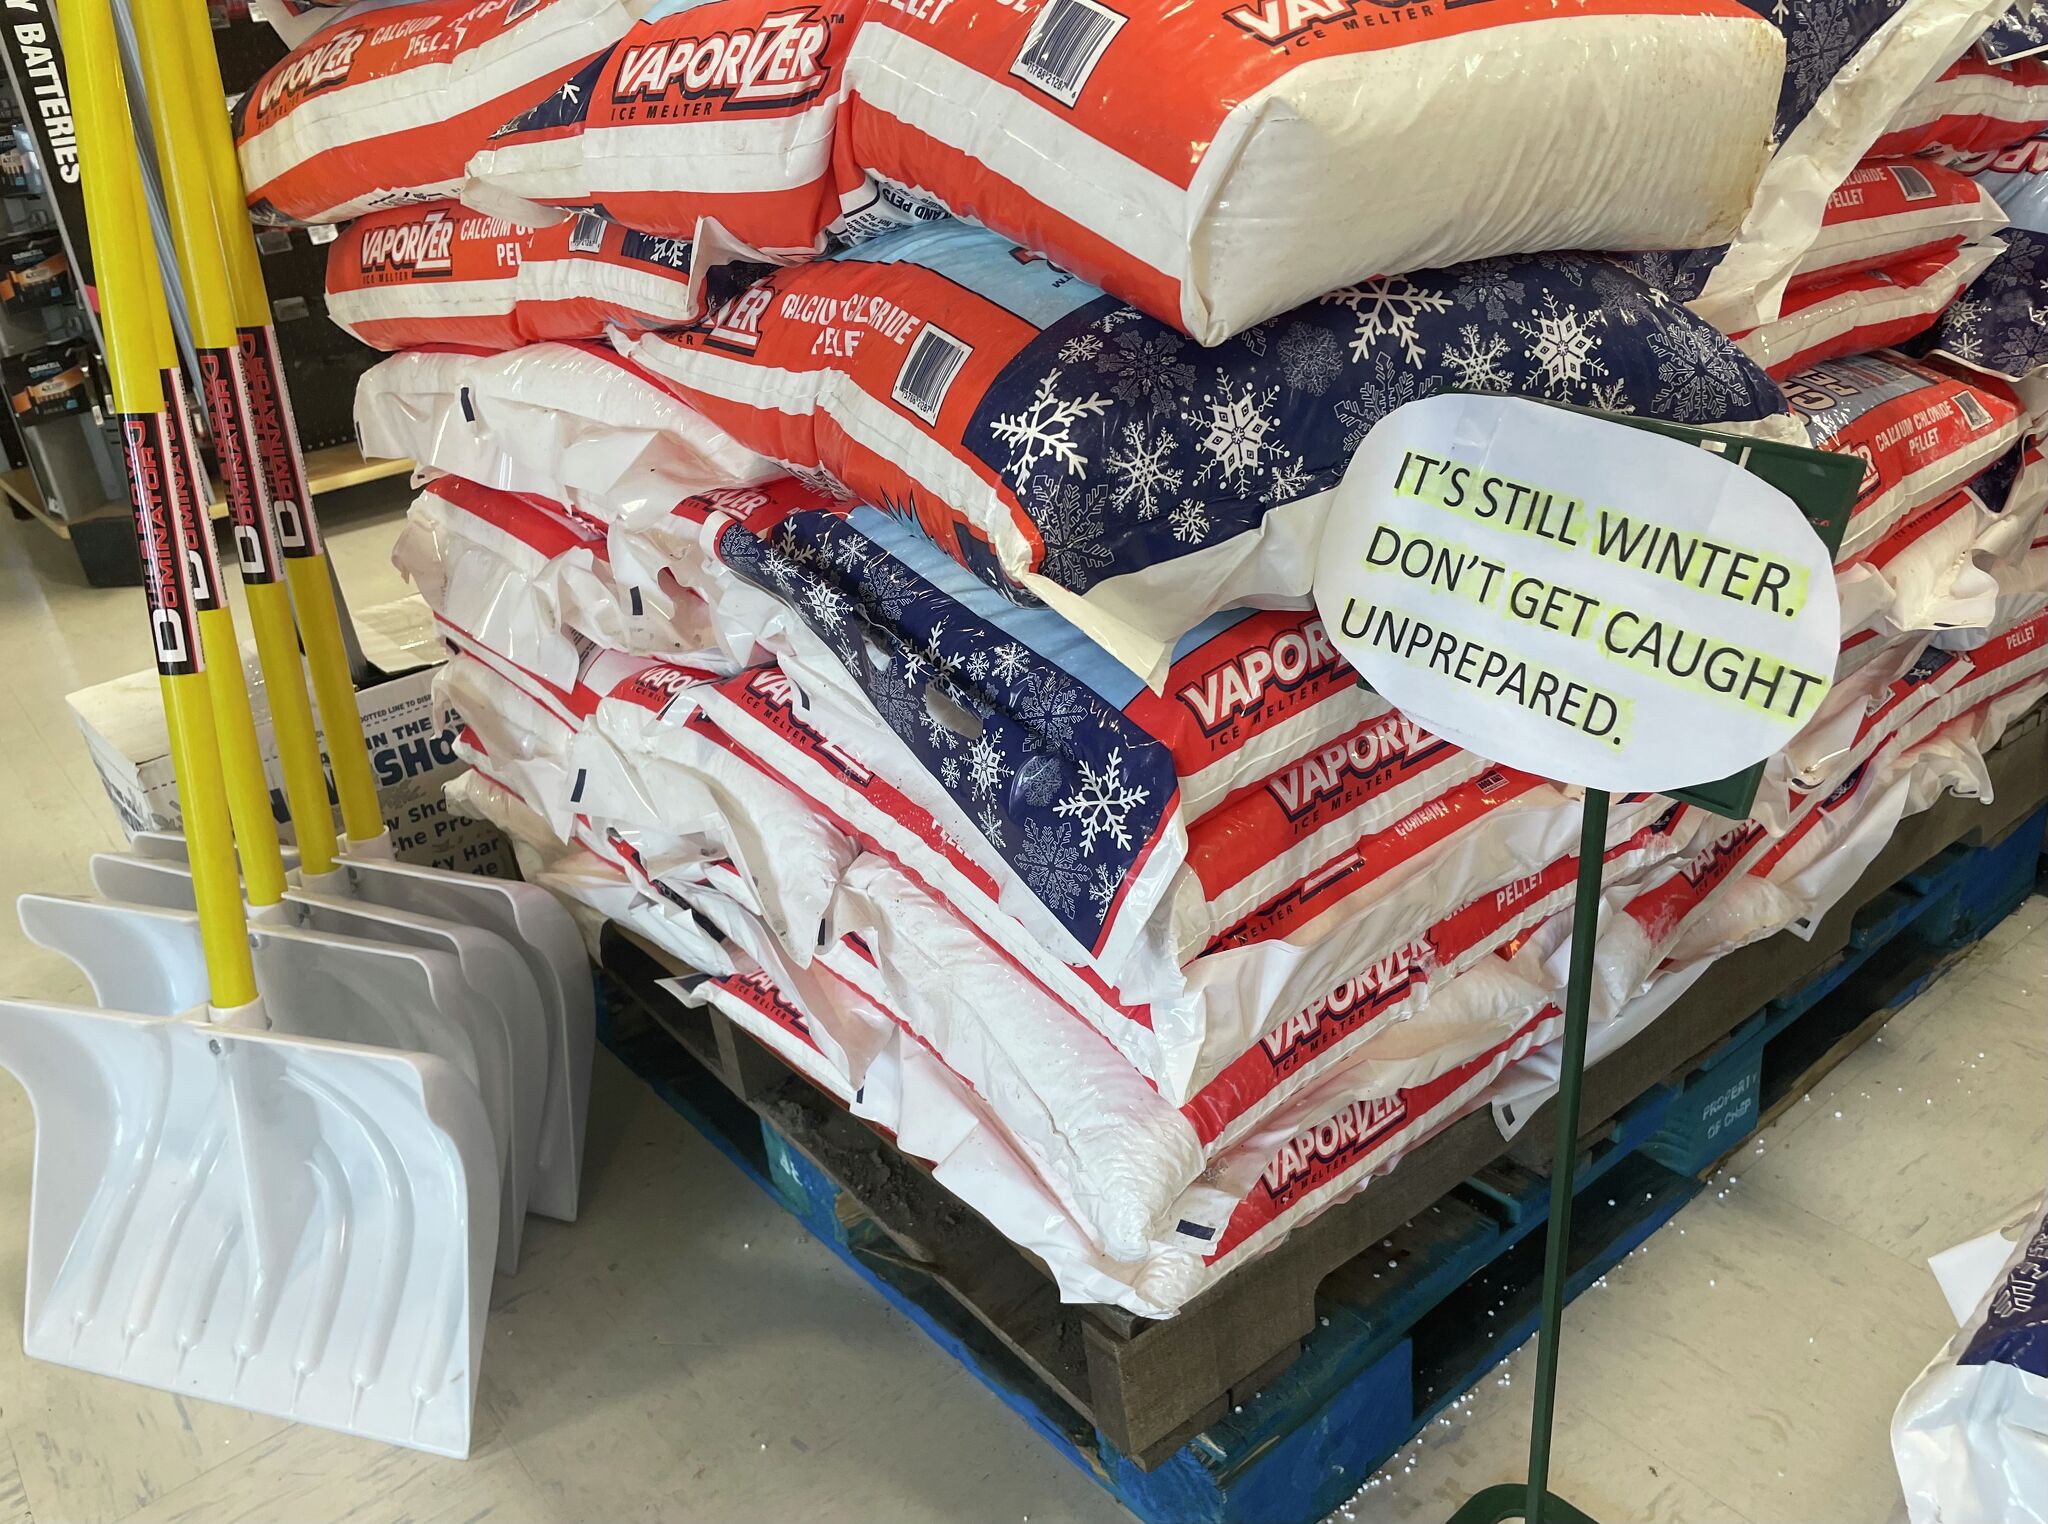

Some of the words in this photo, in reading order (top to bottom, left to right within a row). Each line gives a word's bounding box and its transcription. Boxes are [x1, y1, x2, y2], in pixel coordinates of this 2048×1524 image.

[1343, 5, 1434, 31] MELTER
[616, 12, 827, 99] VAPORIZER
[14, 22, 80, 184] BATTERIES
[611, 106, 636, 121] ICE
[647, 102, 713, 119] MELTER
[361, 208, 454, 269] VAPORIZER
[914, 206, 941, 222] AND
[143, 447, 187, 662] DOMINATOR
[1394, 451, 1471, 508] IT'S
[1475, 477, 1579, 547] STILL
[1598, 510, 1795, 618] WINTER.
[1365, 525, 1506, 604] DON'T
[1510, 577, 1601, 637] GET
[1604, 610, 1824, 719] CAUGHT
[1184, 618, 1350, 727] VAPOR
[1341, 597, 1622, 746] UNPREPARED.
[392, 716, 432, 740] THE
[741, 692, 760, 711] ICE
[763, 710, 808, 745] MELTER
[1210, 725, 1241, 751] ICE
[1252, 680, 1320, 726] MELTER
[373, 722, 465, 787] SHO
[1293, 810, 1320, 835] ICE
[1331, 770, 1393, 810] MELTER
[1495, 870, 1544, 912] PELLET
[1274, 1053, 1299, 1078] ICE
[1309, 1008, 1366, 1054] MELTER
[1300, 1155, 1347, 1188] MELTER
